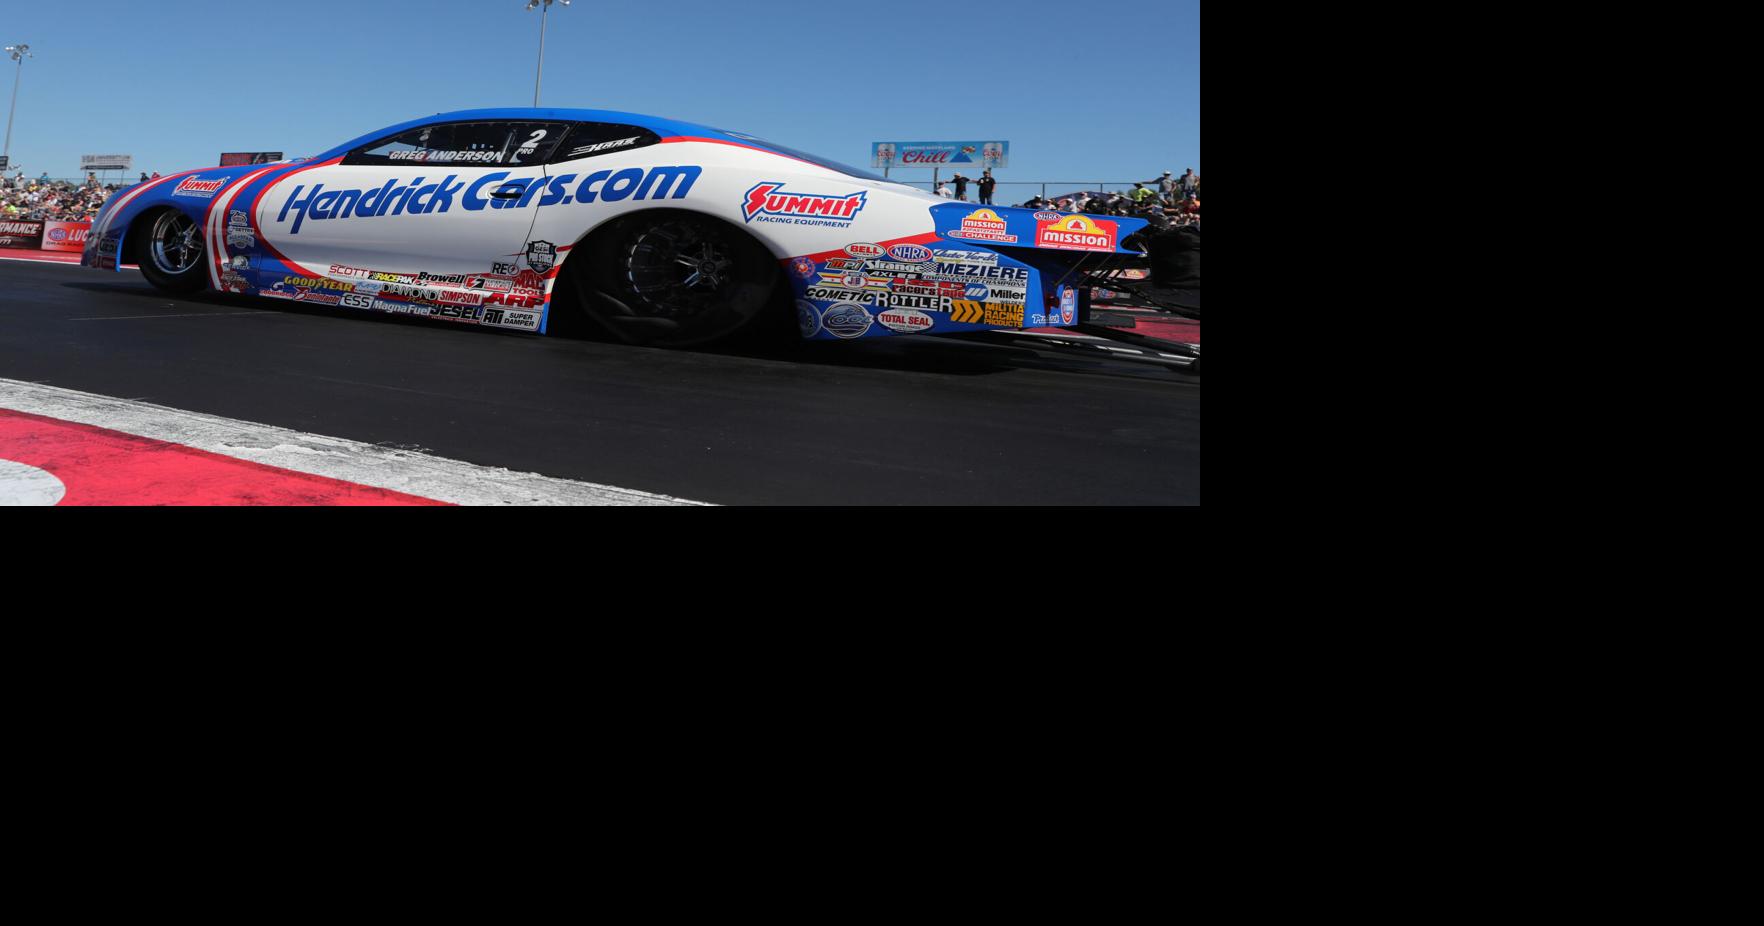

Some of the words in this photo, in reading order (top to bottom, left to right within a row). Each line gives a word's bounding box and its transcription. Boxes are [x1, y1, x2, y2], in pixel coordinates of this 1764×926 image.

[521, 129, 547, 148] 2
[389, 150, 425, 160] GREG
[425, 151, 502, 163] ANDERSON
[902, 151, 951, 164] Chill
[177, 175, 226, 191] SUMMIT
[745, 185, 861, 217] SUMMIT
[756, 215, 792, 224] RACING
[794, 218, 851, 229] EQUIPMENT
[965, 232, 1015, 241] CHALLENGE
[850, 245, 880, 255] BELL
[894, 246, 926, 259] NHRA
[328, 264, 368, 276] SCOTT
[865, 259, 925, 273] Strange
[936, 262, 1028, 279] MEZIERE
[374, 272, 414, 285] RACEPAK
[418, 271, 465, 283] Browell
[513, 270, 545, 289] MAC
[870, 271, 918, 280] AXLES
[382, 282, 438, 301] DIAMOND
[440, 290, 480, 304] SIMPSON
[512, 287, 545, 296] TOOLS
[805, 288, 877, 303] COMETIC
[990, 289, 1026, 300] Miller
[343, 293, 370, 308] ESS
[482, 292, 544, 308] ARP
[876, 291, 952, 313] ROTTLER
[372, 300, 431, 317] MagnaFuel
[430, 304, 480, 320] JESEL
[985, 303, 1024, 313] MILITIA
[483, 308, 504, 324] ATI
[504, 318, 535, 327] DAMPER
[509, 312, 533, 320] SUPER
[880, 313, 907, 324] TOTAL
[908, 315, 930, 326] SEAL
[984, 311, 1024, 322] RACING
[984, 319, 1023, 328] PRODUCTS
